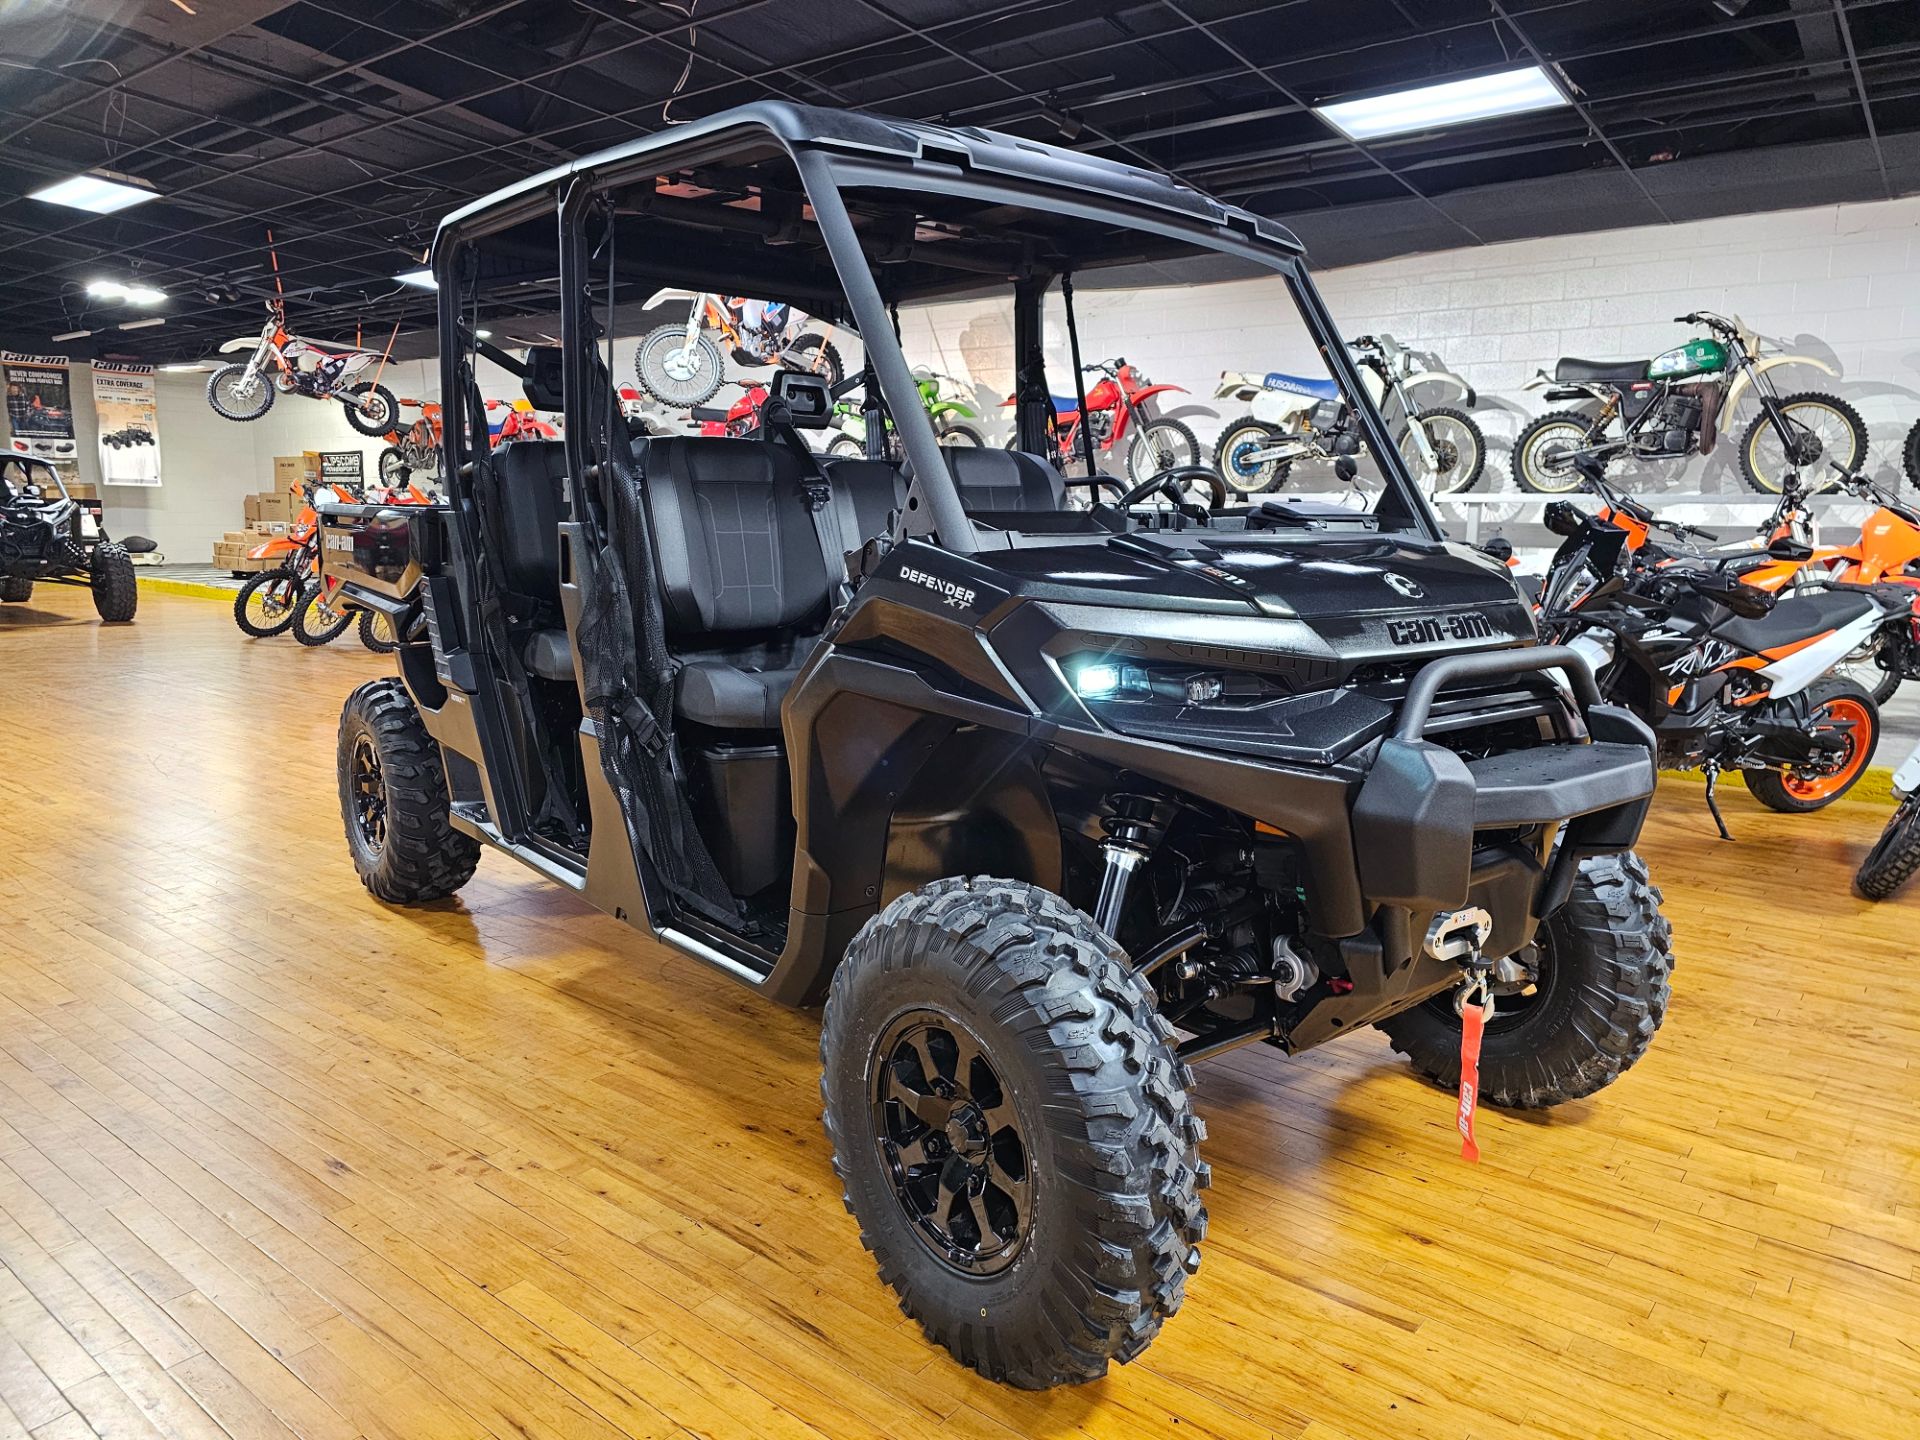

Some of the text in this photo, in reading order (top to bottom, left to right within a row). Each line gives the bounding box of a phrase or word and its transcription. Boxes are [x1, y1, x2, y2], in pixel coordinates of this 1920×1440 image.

[4, 353, 67, 365] can-am
[94, 361, 151, 373] can-am
[96, 378, 143, 388] EXTRA COVERAGE
[1267, 377, 1311, 394] HUSQVARNA
[326, 534, 354, 551] can-am
[900, 566, 976, 603] DEFENDER
[943, 595, 972, 610] XT
[1386, 612, 1492, 645] can-am
